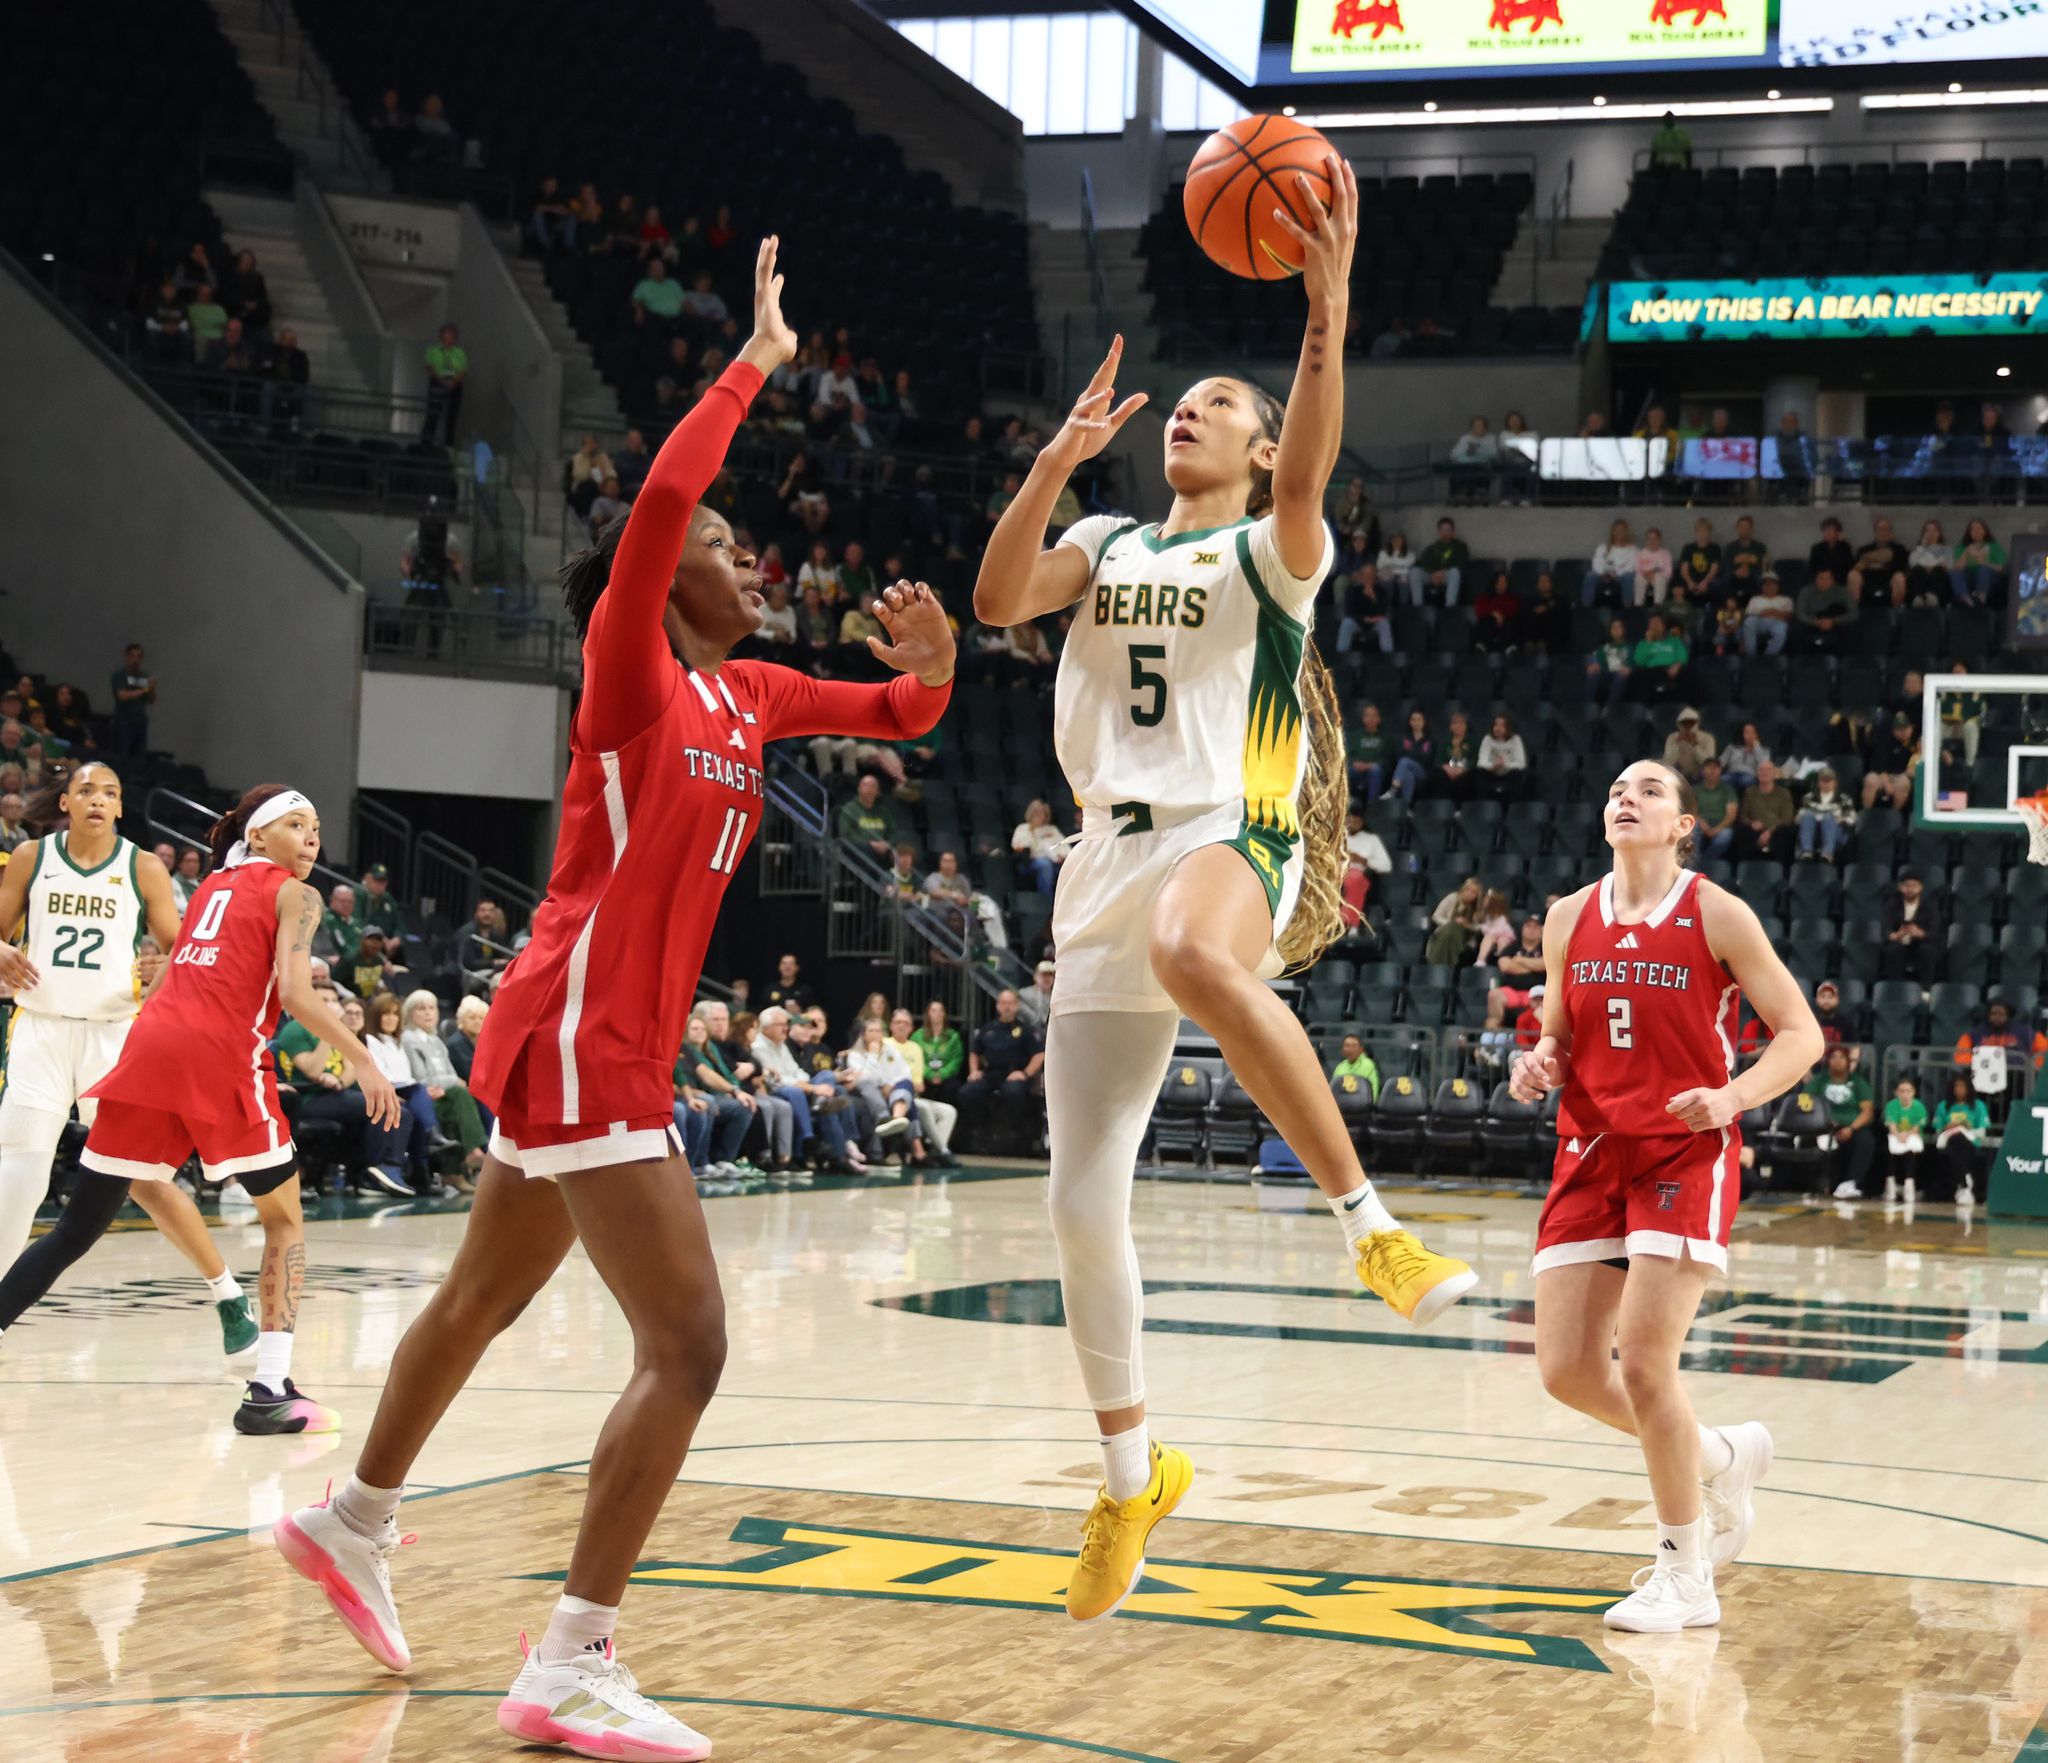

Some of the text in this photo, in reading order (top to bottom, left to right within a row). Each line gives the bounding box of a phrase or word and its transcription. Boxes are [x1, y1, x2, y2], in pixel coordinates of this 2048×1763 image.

[1629, 291, 2042, 323] NOW THIS IS A BEAR NECESSITY
[1094, 583, 1208, 629] BEARS
[1128, 644, 1168, 728] 5
[684, 747, 746, 792] TEXAS
[709, 806, 749, 876] 11
[48, 892, 117, 920] BEARS
[191, 889, 234, 941] 0
[51, 925, 105, 971] 22
[1571, 960, 1690, 991] TEXAS TECH
[1606, 997, 1633, 1050] 2
[2006, 1155, 2042, 1174] Your
